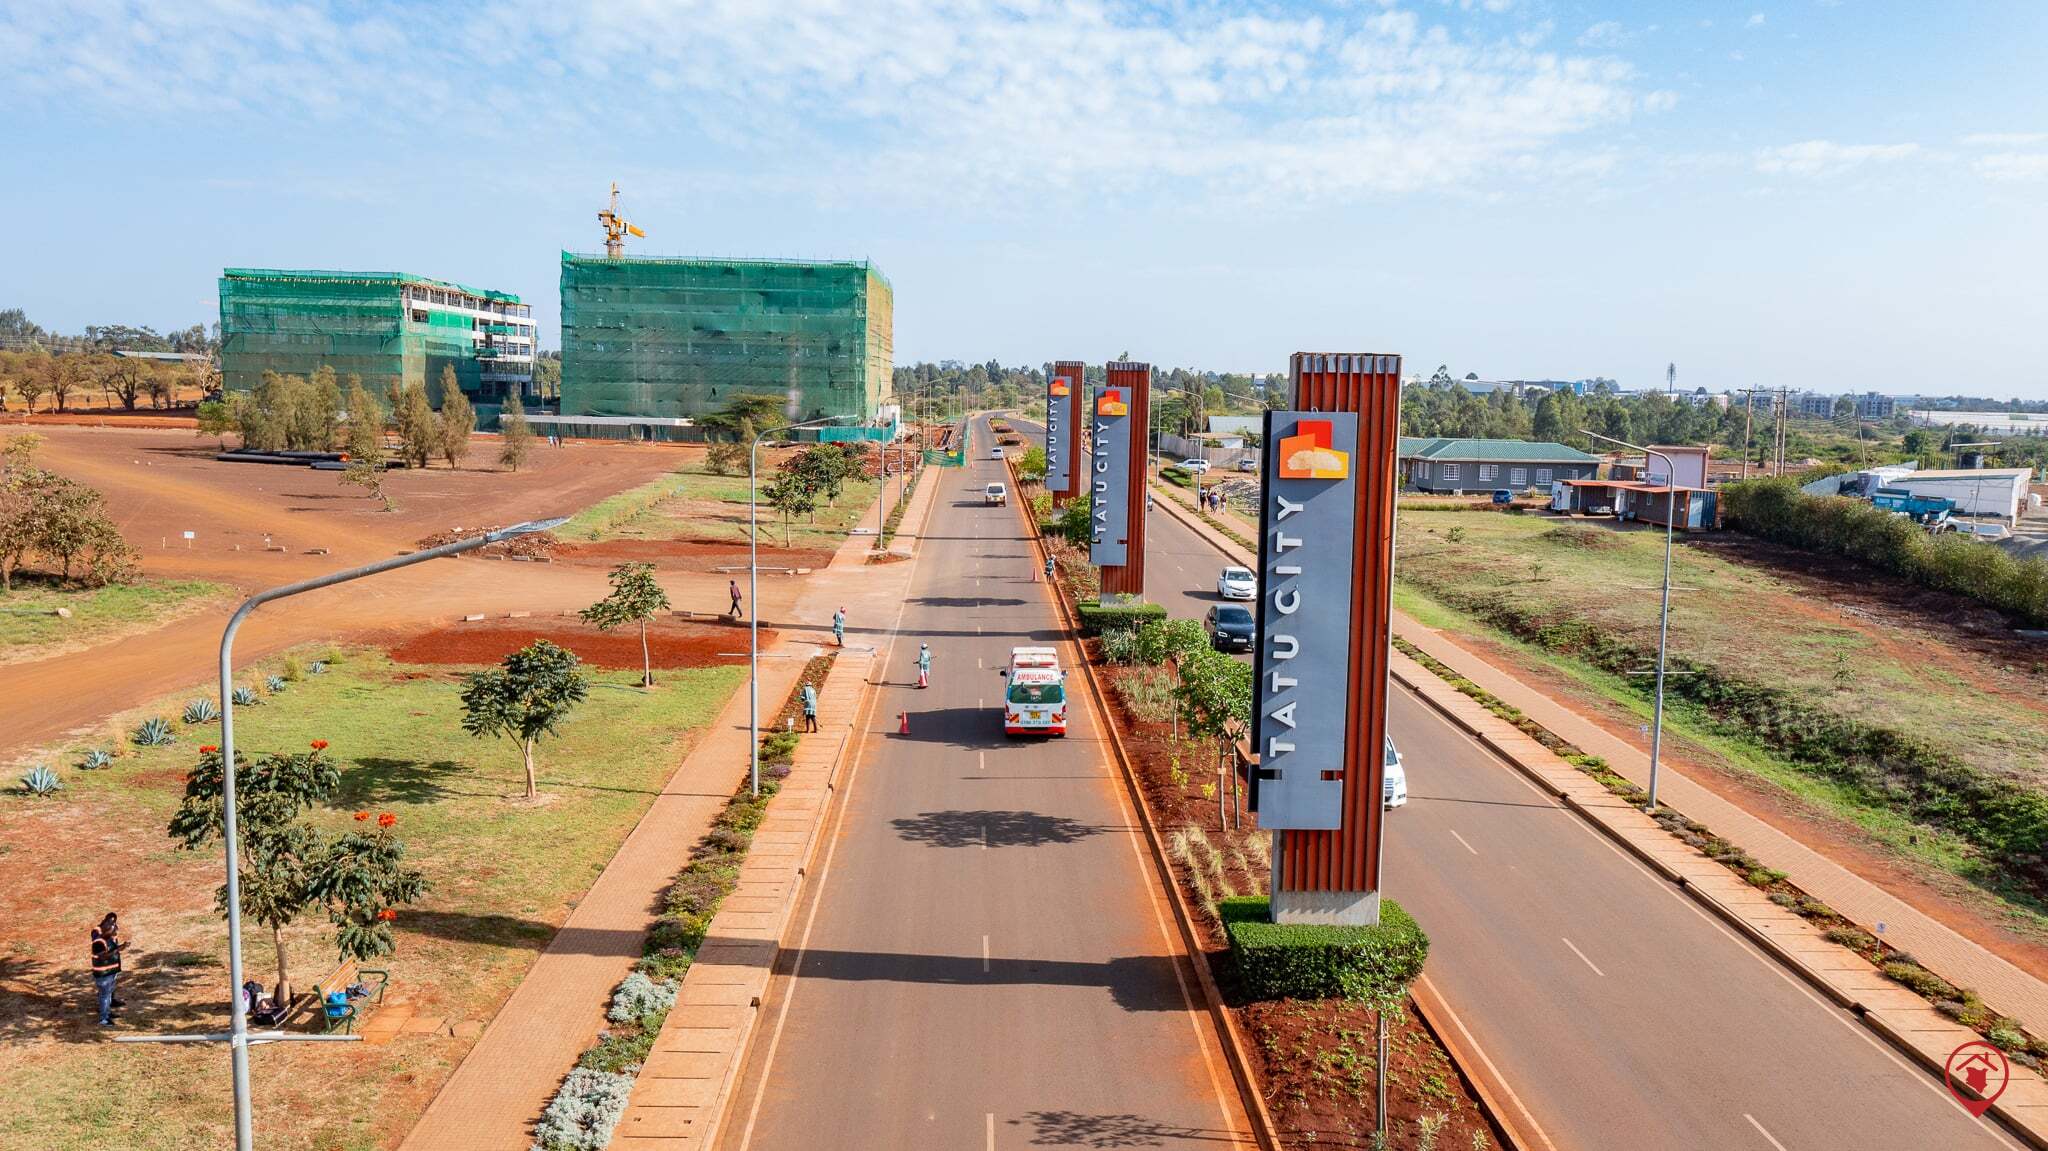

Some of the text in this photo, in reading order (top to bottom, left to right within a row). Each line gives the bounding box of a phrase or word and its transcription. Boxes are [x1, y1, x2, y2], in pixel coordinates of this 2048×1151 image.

[1048, 399, 1059, 470] TATU CITY
[1095, 422, 1110, 535] TATU CITY
[1269, 496, 1304, 758] TATU CITY
[1017, 673, 1054, 681] AMBULANCE
